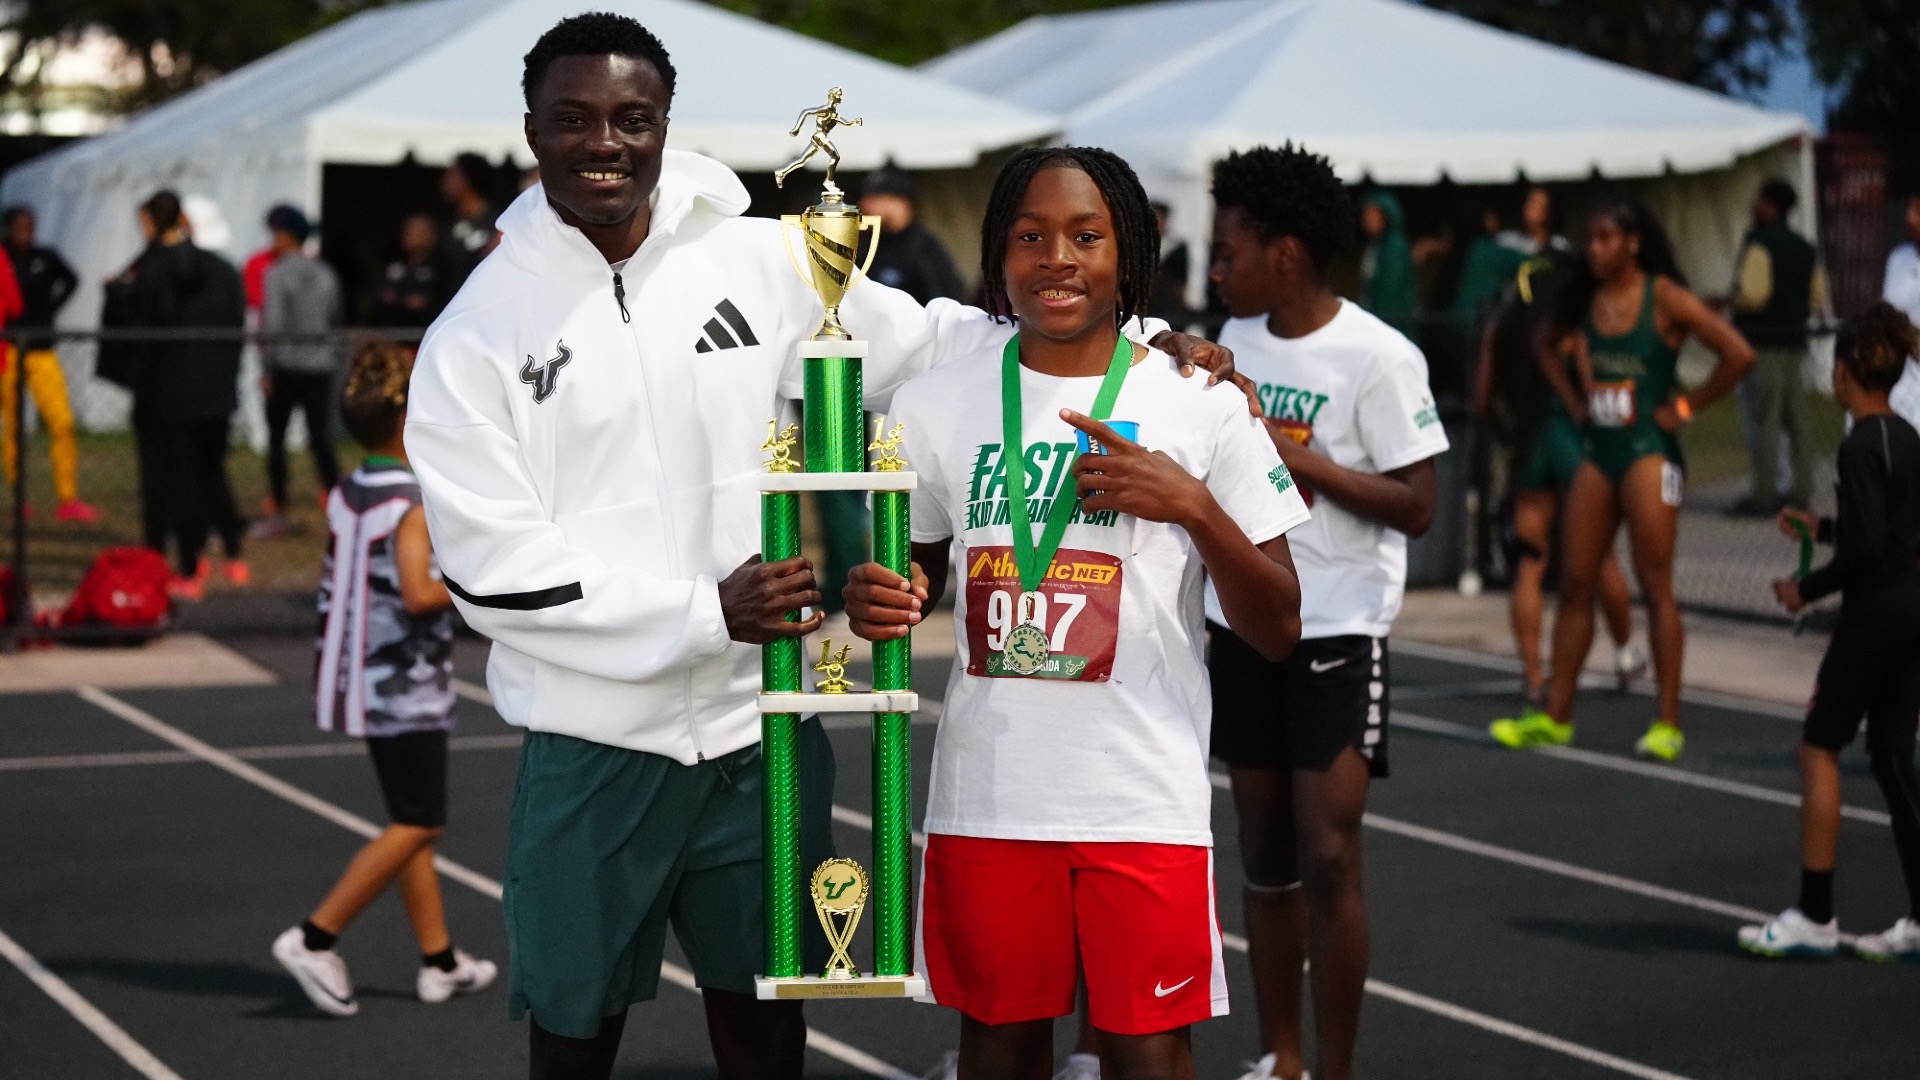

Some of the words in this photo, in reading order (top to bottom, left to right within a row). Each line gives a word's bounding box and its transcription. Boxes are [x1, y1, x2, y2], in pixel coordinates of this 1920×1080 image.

[1258, 383, 1328, 425] STEST
[966, 441, 1080, 502] FAST
[965, 500, 993, 530] KID
[968, 551, 1072, 580] Athic
[1076, 567, 1111, 581] NET
[1013, 629, 1044, 647] FASTEST
